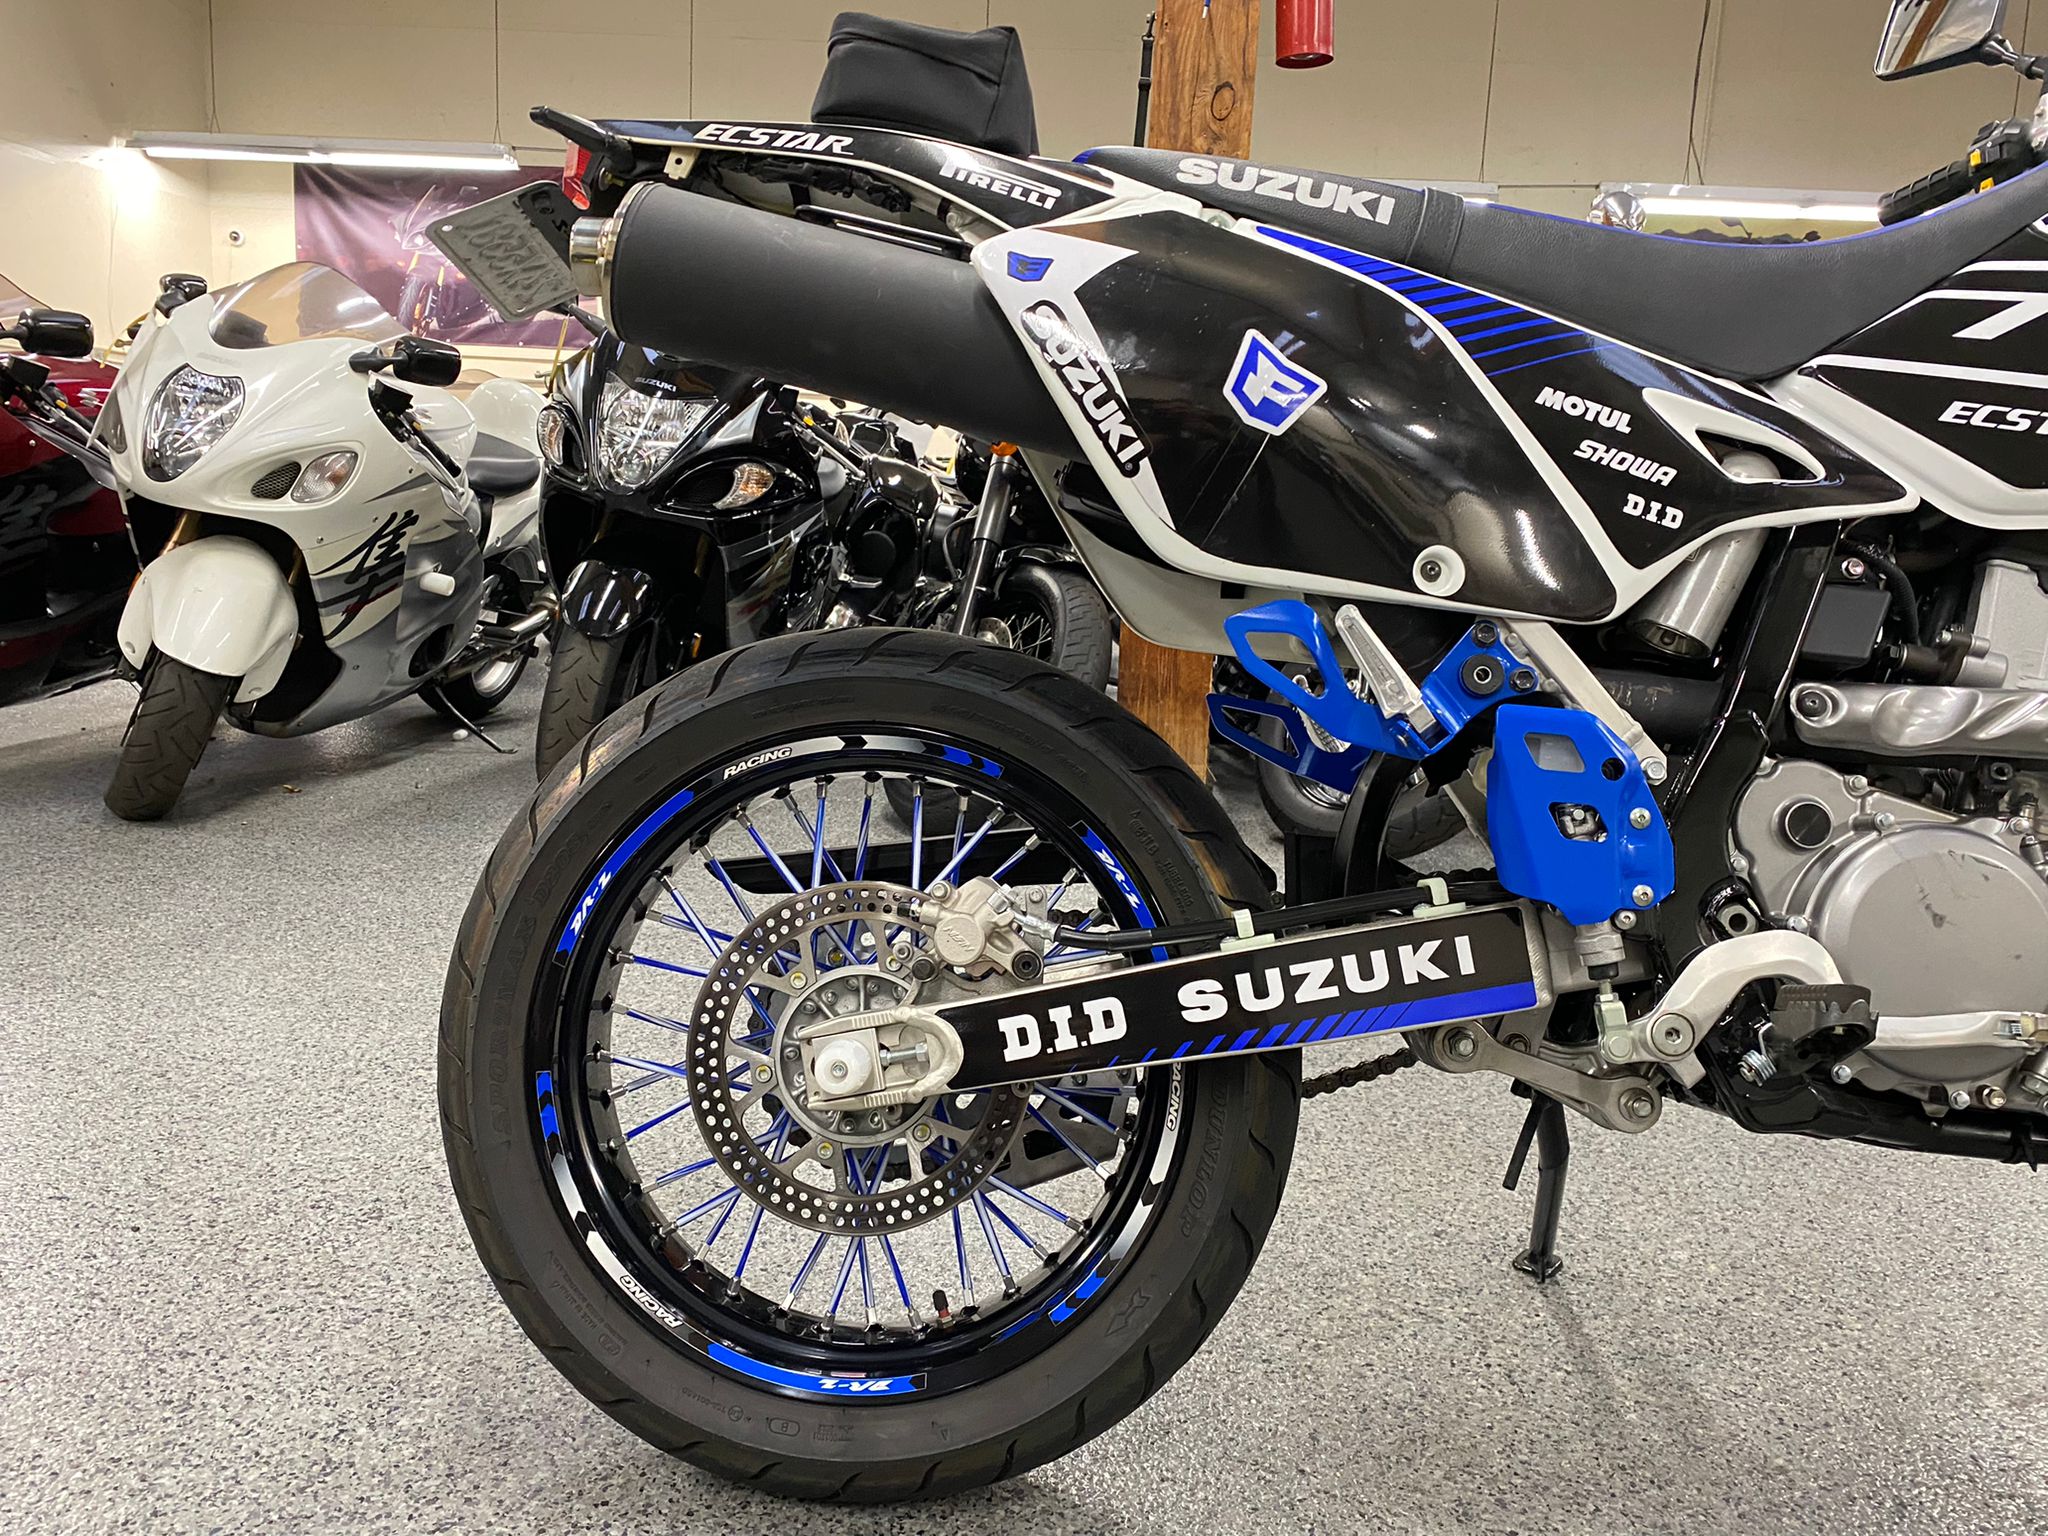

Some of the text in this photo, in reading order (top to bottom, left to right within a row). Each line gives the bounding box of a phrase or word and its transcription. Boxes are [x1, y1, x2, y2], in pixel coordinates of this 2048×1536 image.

[694, 123, 855, 155] ECSTAR
[938, 159, 1063, 210] PIRELLI
[1176, 157, 1397, 225] SUZUKI
[634, 376, 677, 392] SUZUKI
[1022, 303, 1145, 464] SUZUKI
[1535, 386, 1633, 434] MOTUL
[1573, 440, 1678, 488] SHOWA
[1622, 493, 1685, 530] D.I.D
[722, 746, 793, 781] RACING
[998, 934, 1476, 1062] D.I.D SUZUKI
[1181, 1079, 1228, 1238] DUNLOP
[620, 1274, 684, 1329] RACING
